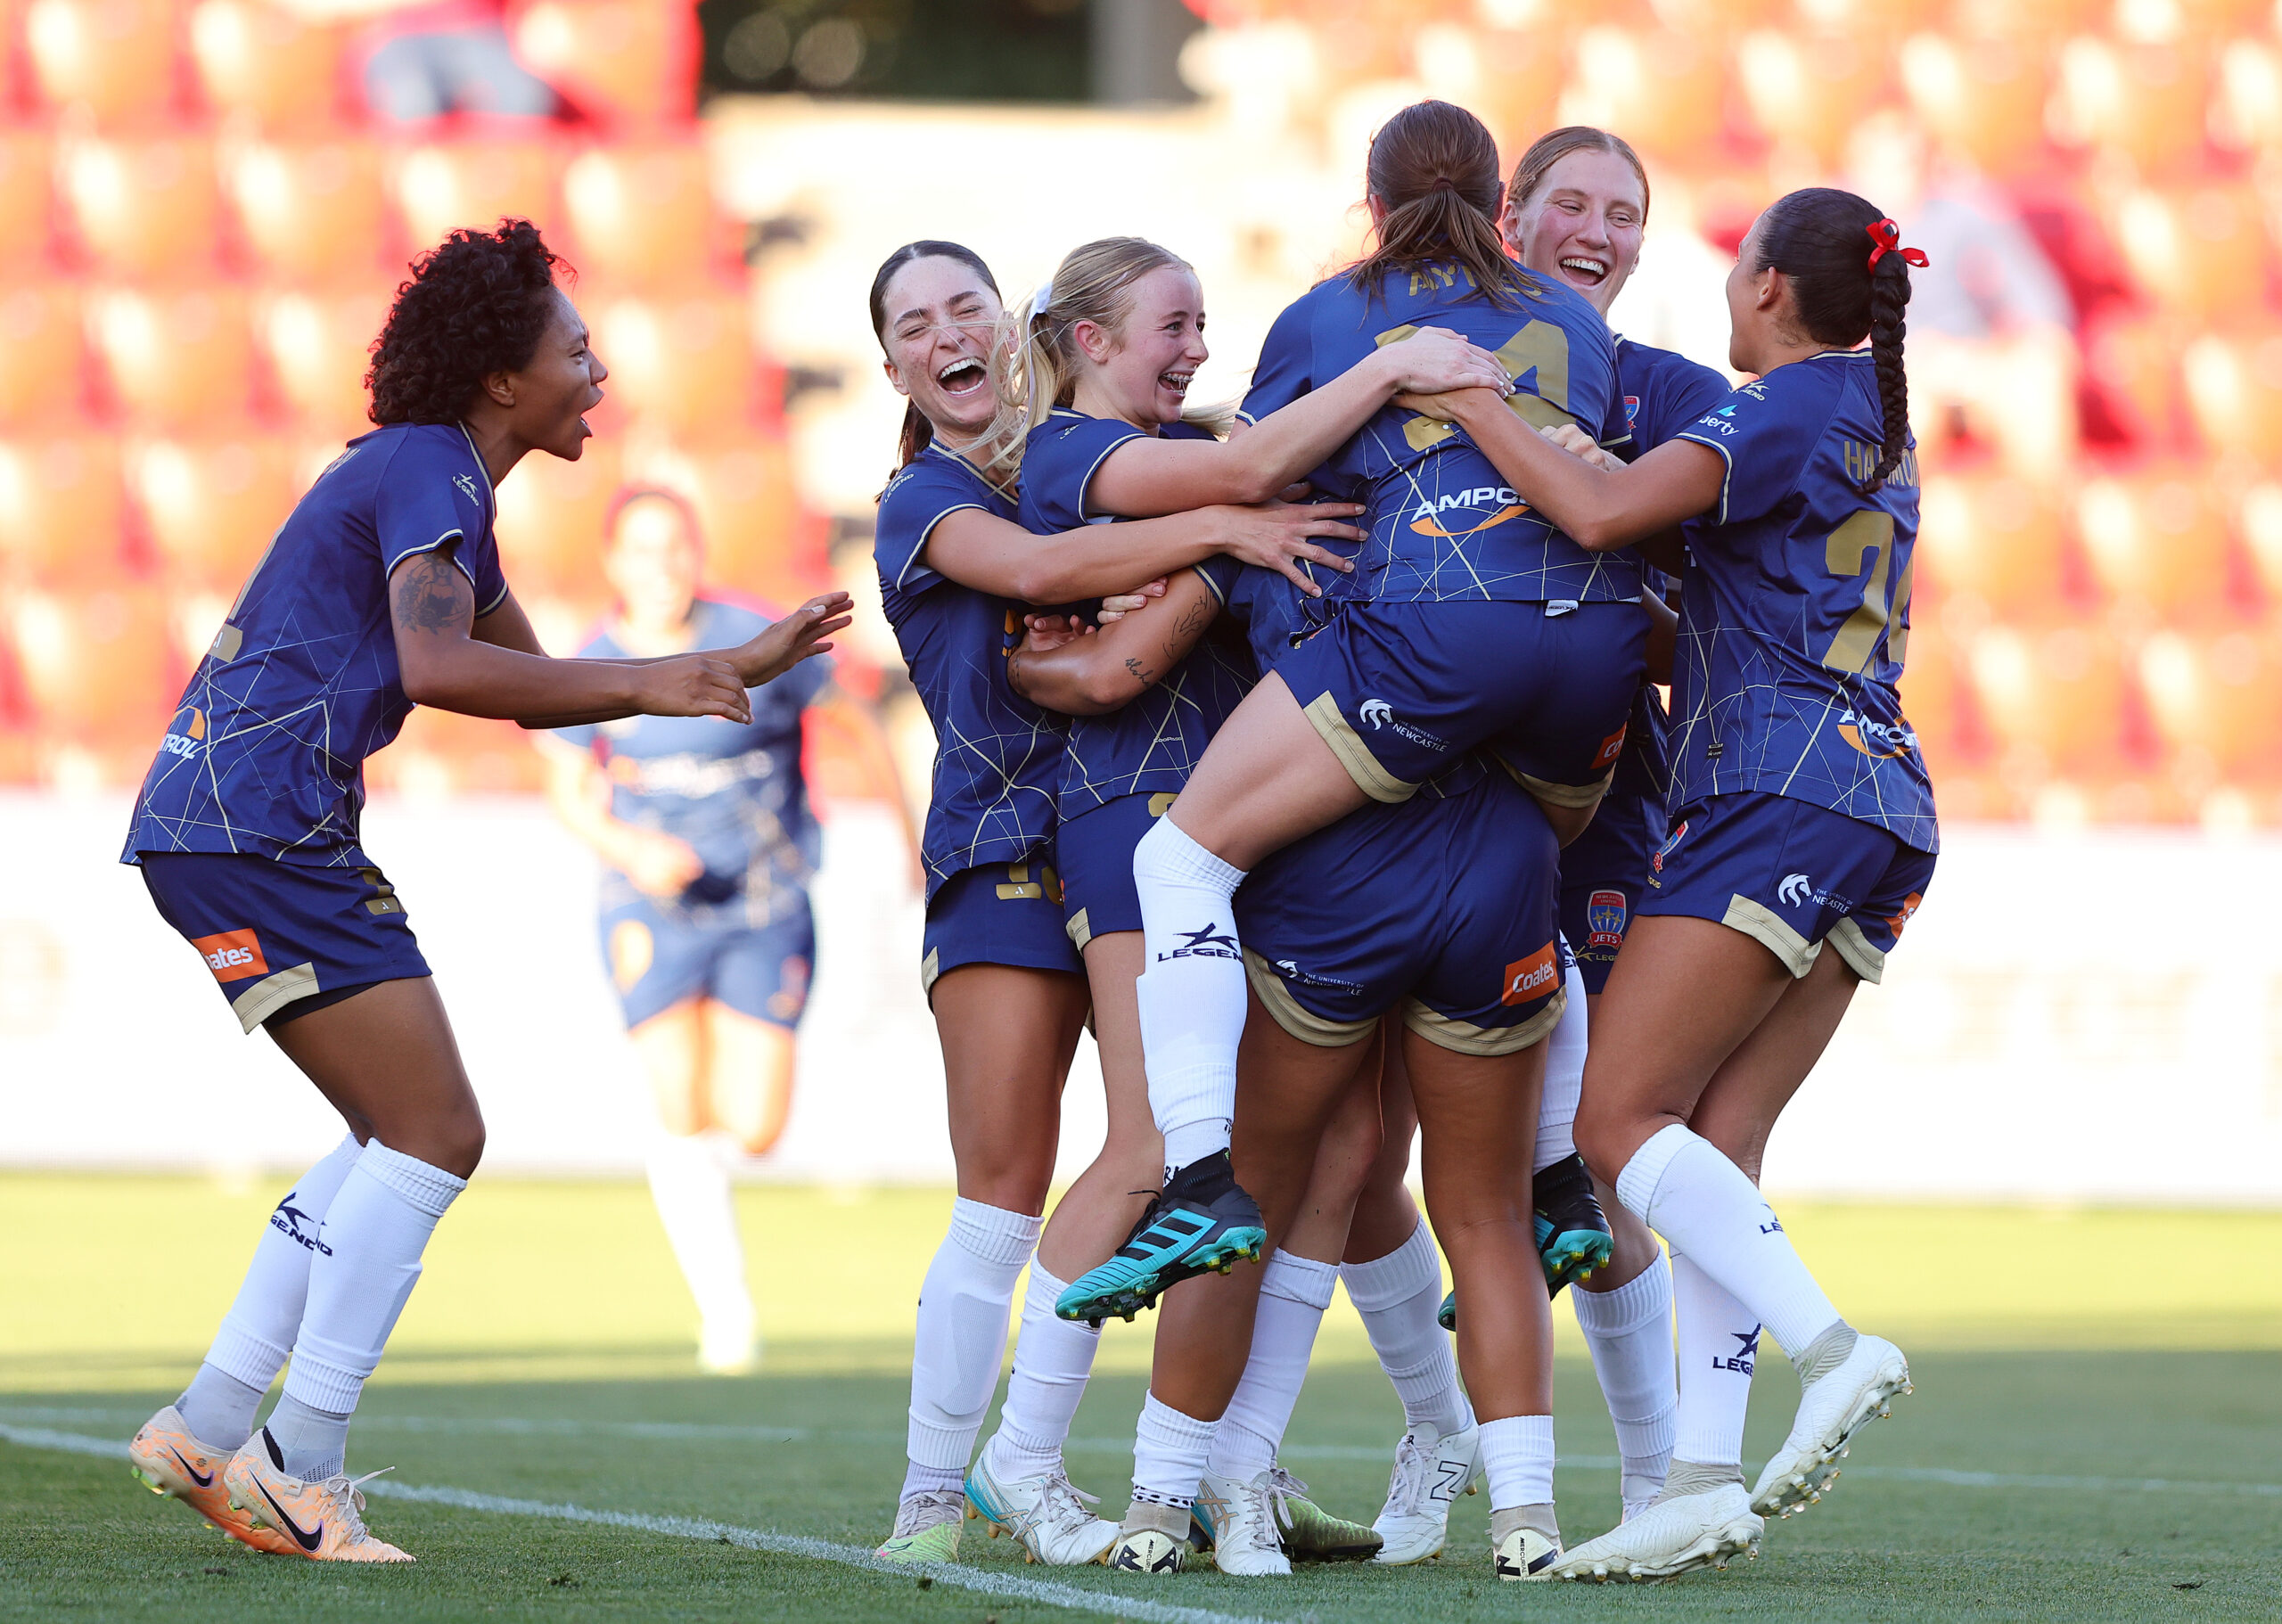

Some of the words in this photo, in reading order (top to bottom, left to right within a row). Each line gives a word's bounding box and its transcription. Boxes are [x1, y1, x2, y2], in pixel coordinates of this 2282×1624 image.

[452, 476, 480, 506] LEGEND
[884, 473, 915, 504] LEGEND
[1392, 723, 1448, 752] NEWCASTLE
[1410, 725, 1442, 742] UNIVERSITY
[1811, 894, 1851, 915] NEASTLE
[1594, 934, 1617, 944] JETS
[1157, 947, 1244, 964] LEGEN
[1596, 954, 1616, 962] LEG
[1318, 976, 1355, 987] UNIVERSITY
[1513, 960, 1555, 993] Coates
[1519, 1537, 1528, 1574] MERCURIAL
